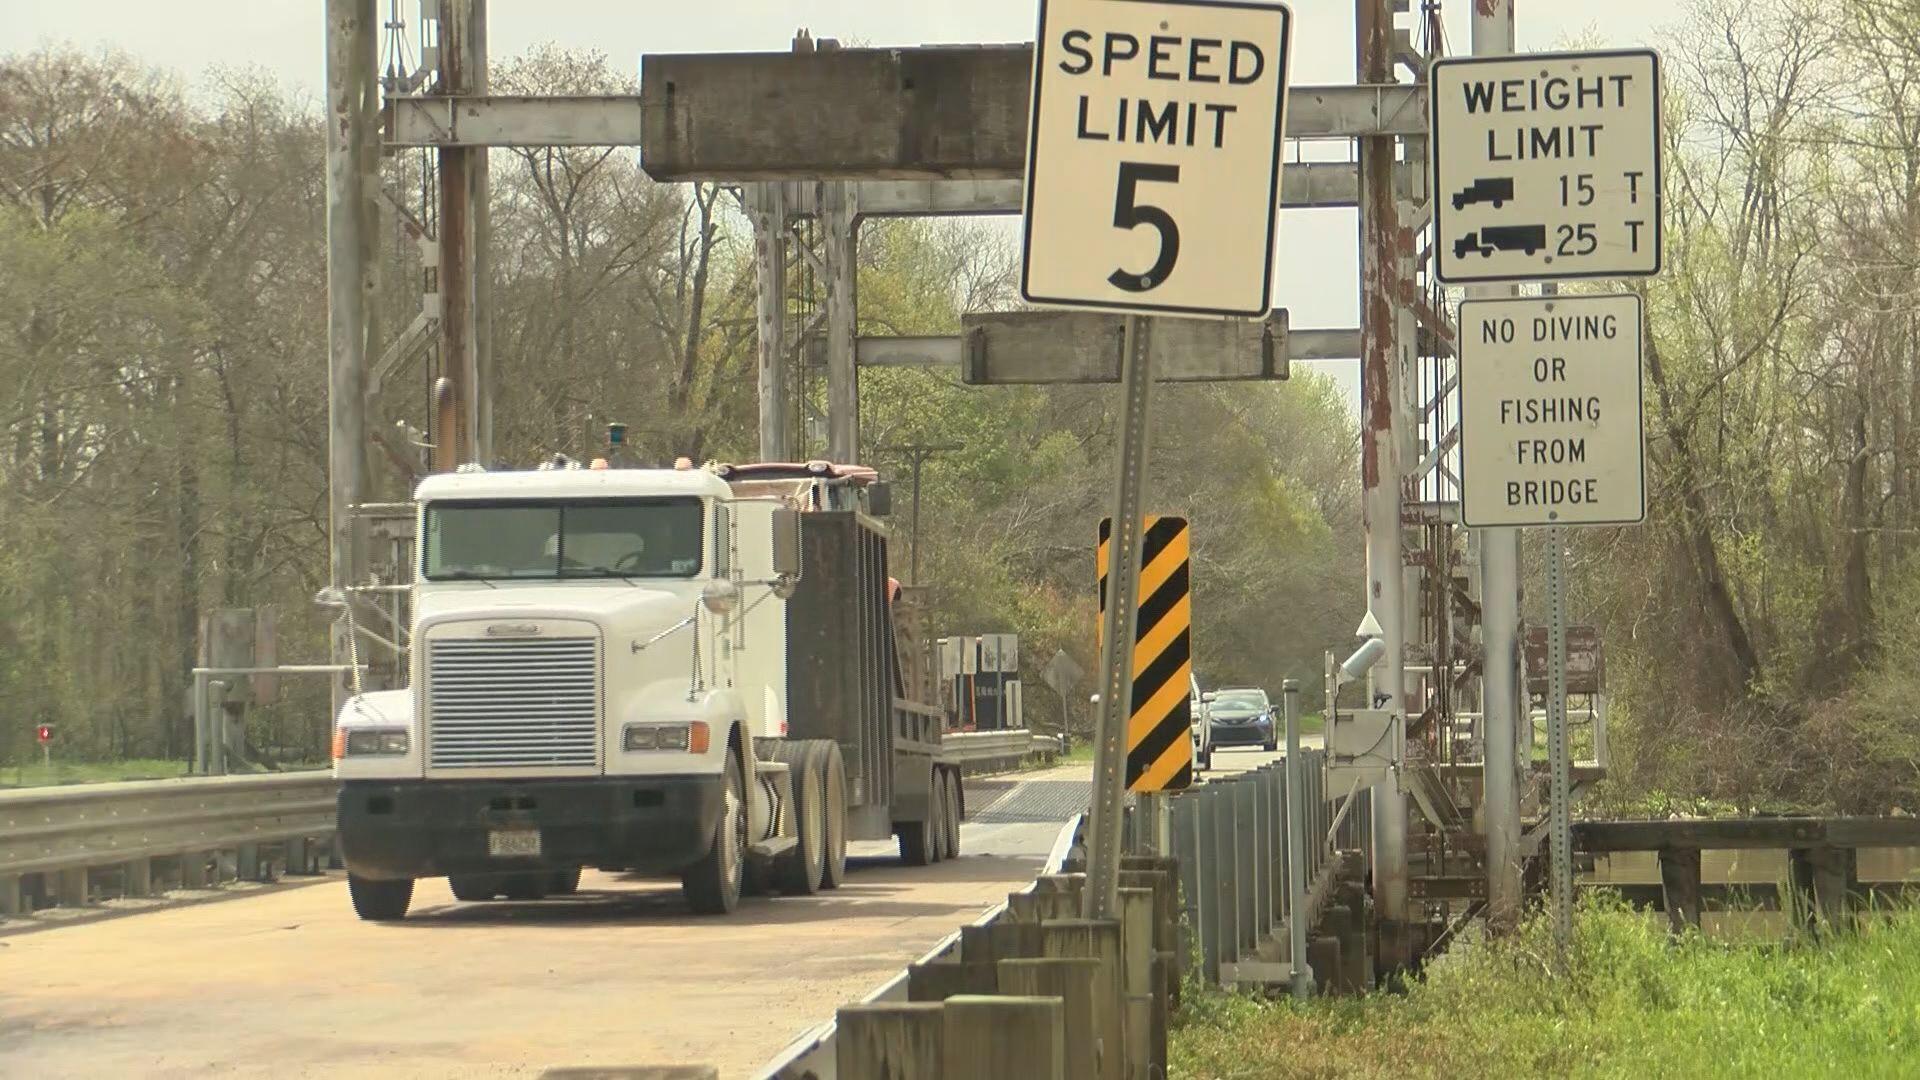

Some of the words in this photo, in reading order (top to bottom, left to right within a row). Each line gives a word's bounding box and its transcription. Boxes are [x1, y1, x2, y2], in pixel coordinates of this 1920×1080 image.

[1059, 30, 1264, 85] SPEED
[1463, 75, 1632, 113] WEIGHT
[1077, 95, 1237, 148] LIMIT
[1488, 125, 1603, 161] LIMIT
[1560, 174, 1595, 207] 15
[1623, 172, 1643, 204] T
[1107, 161, 1180, 292] 5
[1557, 223, 1597, 256] 25
[1624, 221, 1644, 253] T
[1483, 318, 1515, 344] NO
[1533, 315, 1617, 342] DIVING
[1534, 358, 1566, 382] OR
[1501, 396, 1600, 424] FISHING
[1518, 438, 1585, 464] FROM
[1507, 479, 1598, 505] BRIDGE
